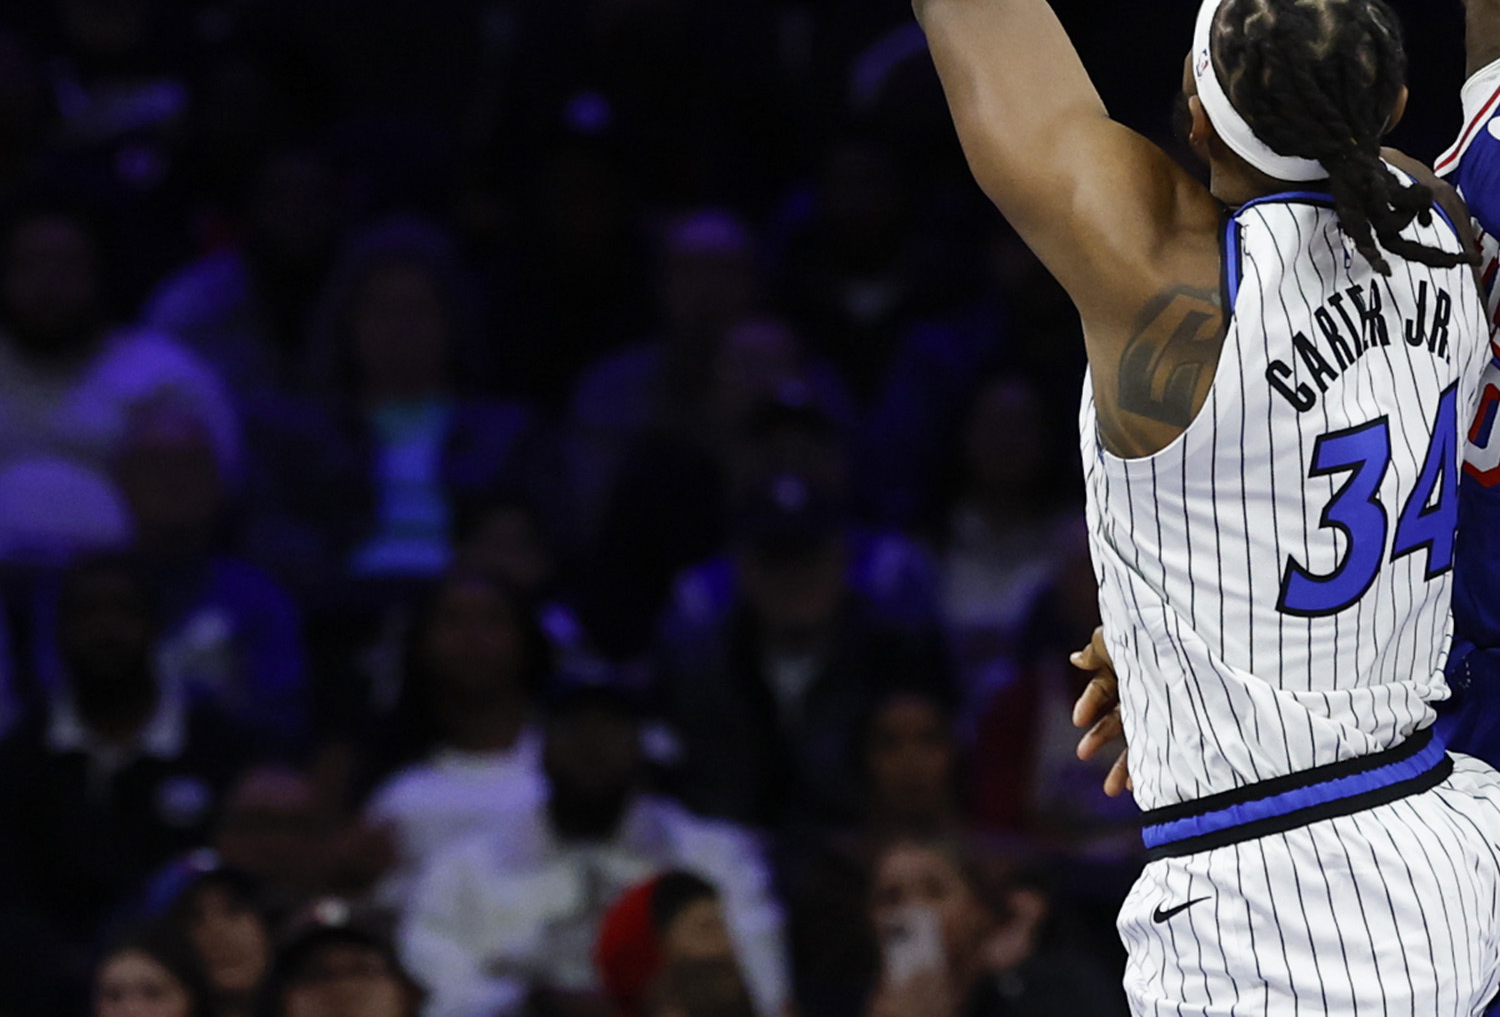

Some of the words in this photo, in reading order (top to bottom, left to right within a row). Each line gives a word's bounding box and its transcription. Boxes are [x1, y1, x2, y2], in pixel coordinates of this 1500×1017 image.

[1265, 278, 1391, 413] CARTER
[1405, 280, 1451, 365] JR.
[1275, 377, 1460, 619] 34
